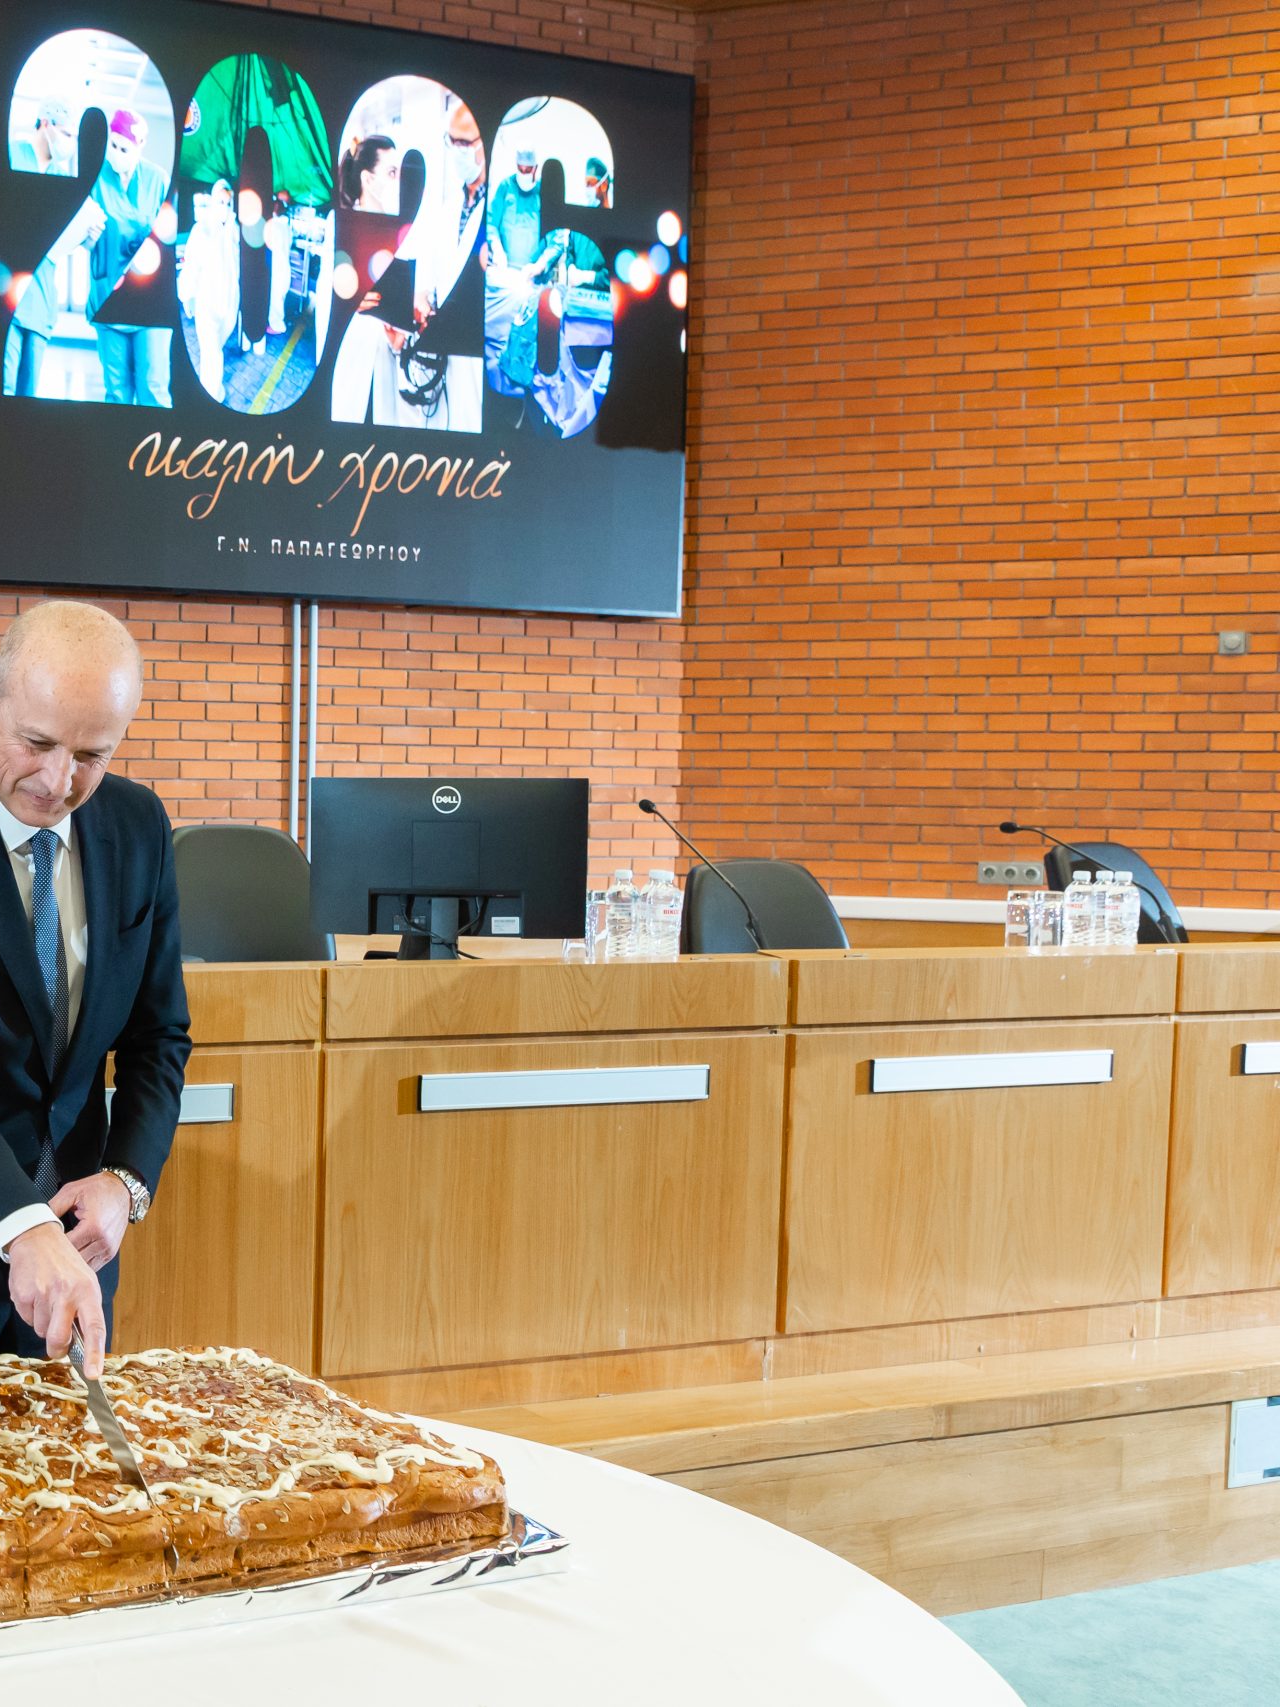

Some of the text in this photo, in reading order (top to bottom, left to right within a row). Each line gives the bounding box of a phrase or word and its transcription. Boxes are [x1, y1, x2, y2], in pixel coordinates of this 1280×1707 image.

[2, 27, 615, 440] 2026
[316, 443, 512, 537] χρονιά
[216, 535, 422, 562] Γ.Ν. ΠΑΠΑΓΕΩΡΓΙΟΥ
[435, 795, 459, 804] DELL
